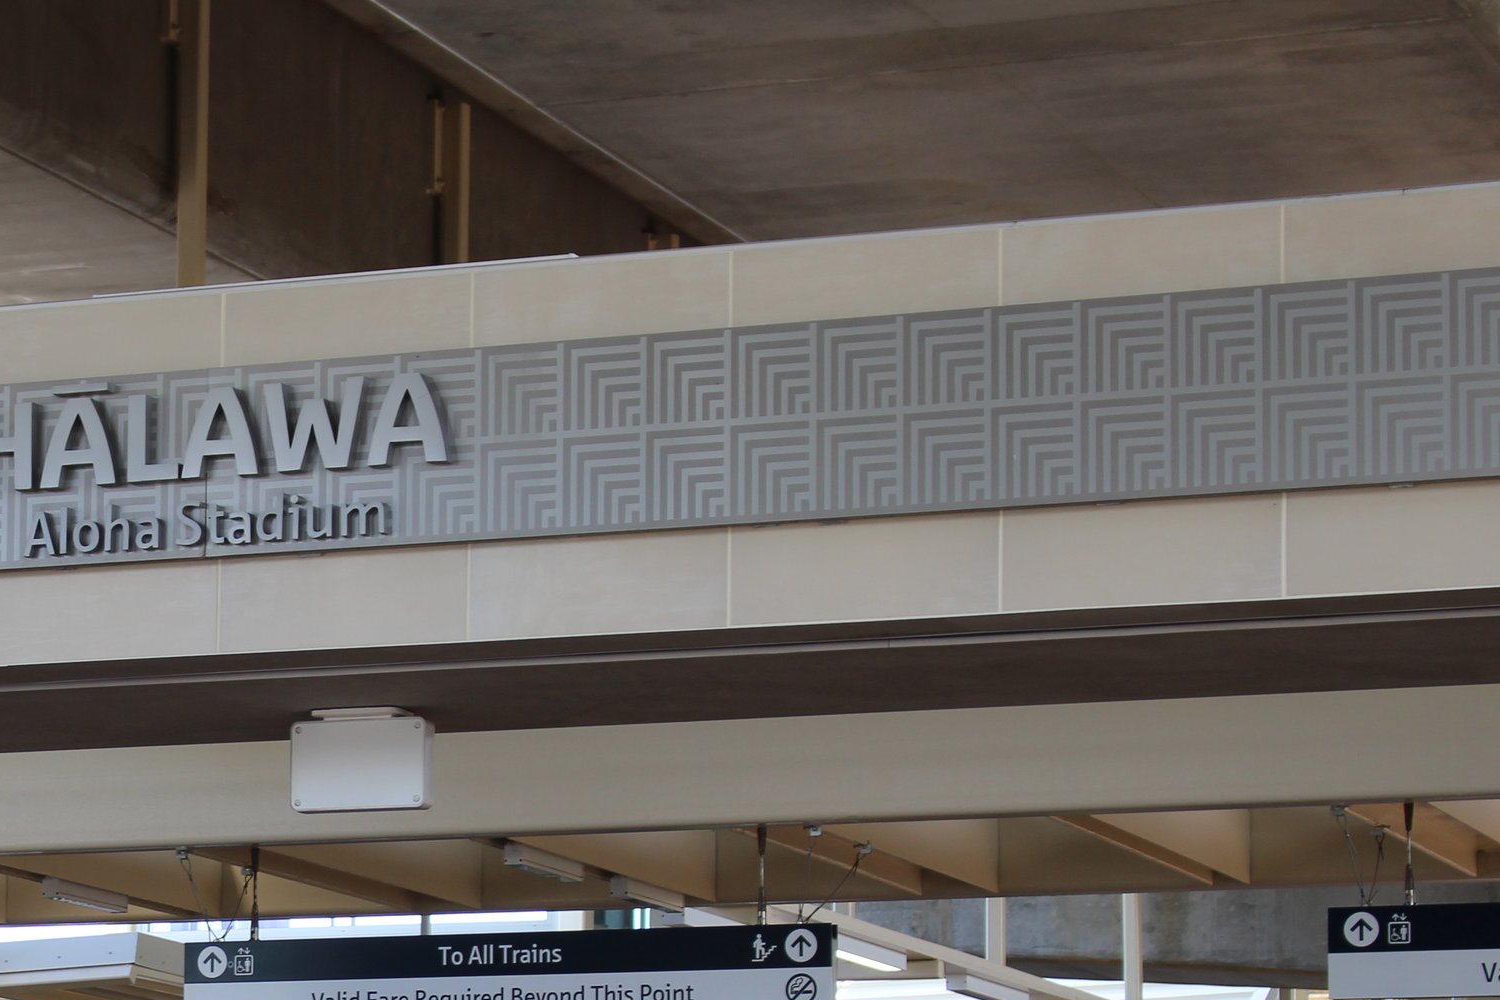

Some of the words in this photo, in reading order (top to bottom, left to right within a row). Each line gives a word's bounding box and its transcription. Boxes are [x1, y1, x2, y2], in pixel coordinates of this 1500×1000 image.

[24, 503, 161, 558] Aloha
[176, 493, 390, 547] Stadium
[438, 946, 463, 966] To
[468, 944, 494, 965] All
[499, 943, 563, 964] Trains
[1481, 962, 1500, 983] V
